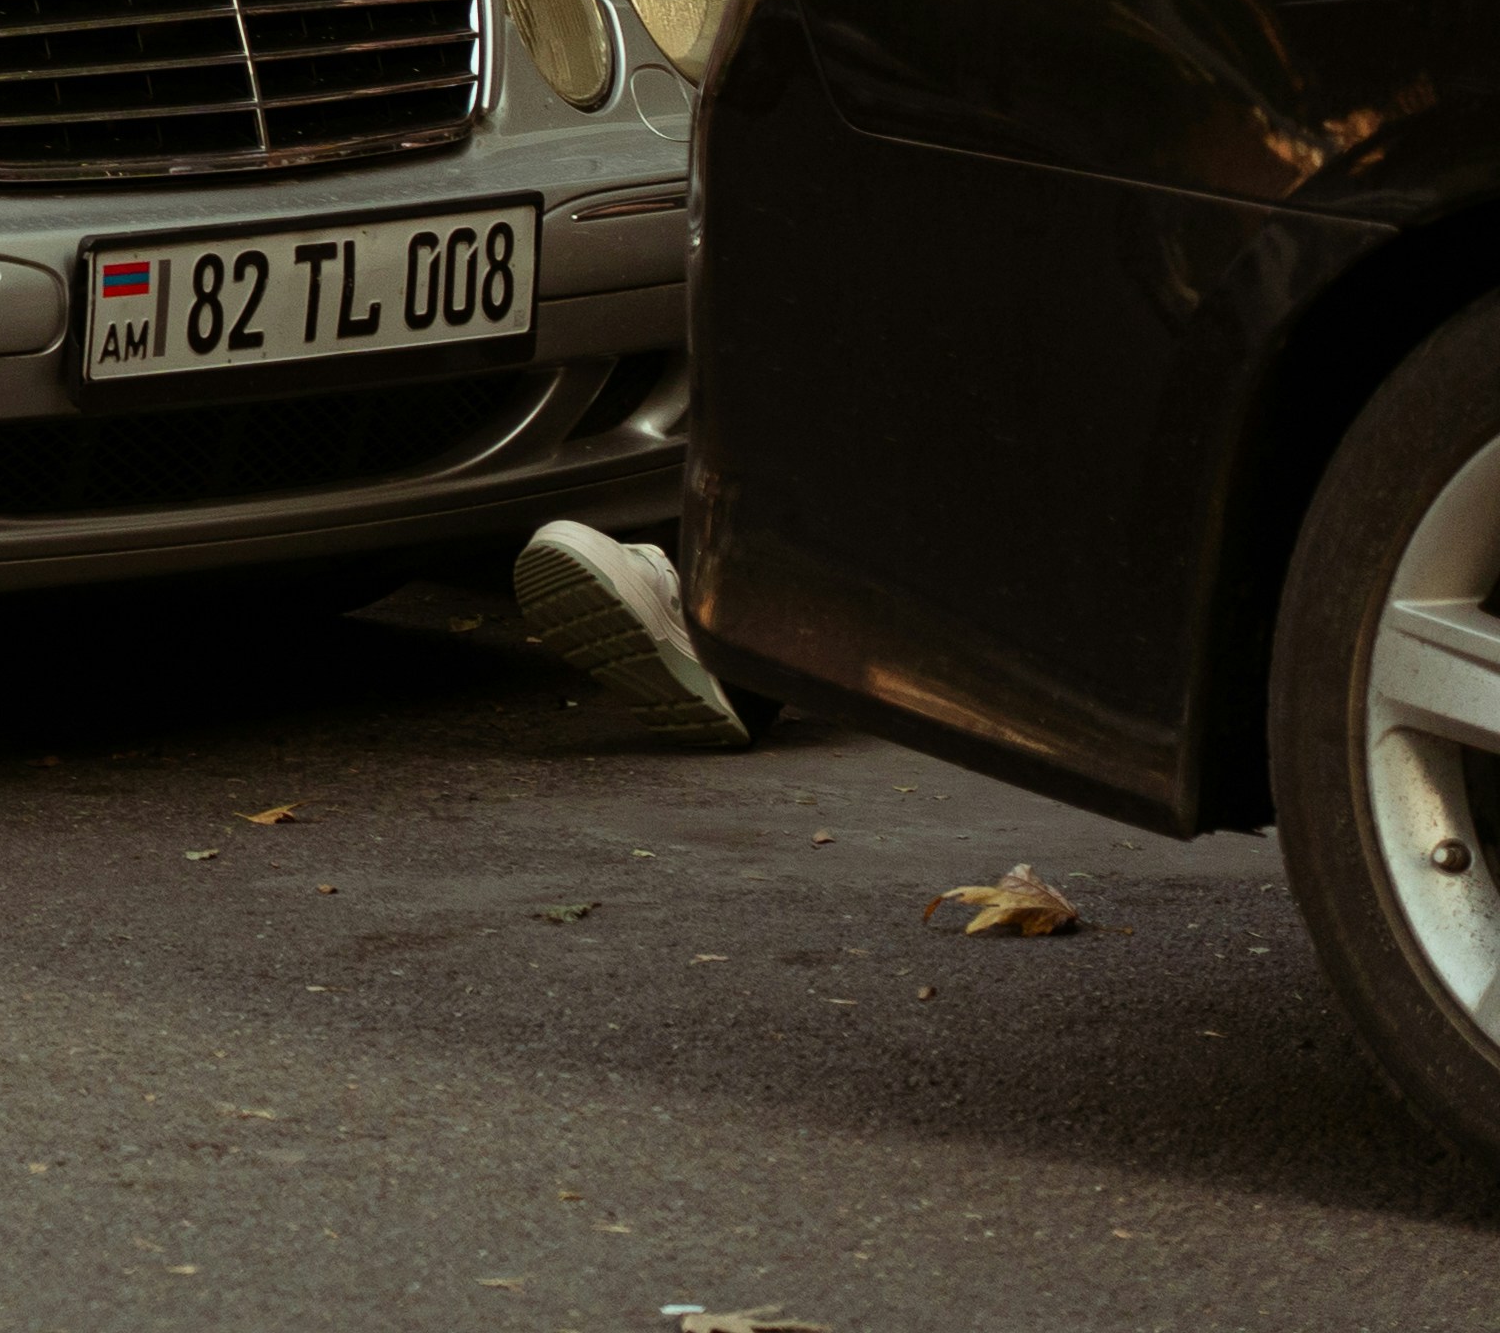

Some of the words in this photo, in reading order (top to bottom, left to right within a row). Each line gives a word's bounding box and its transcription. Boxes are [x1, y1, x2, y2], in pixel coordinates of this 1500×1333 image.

[97, 319, 150, 364] AM
[186, 249, 269, 354] 82
[294, 239, 381, 343] TL
[404, 220, 516, 331] 008
